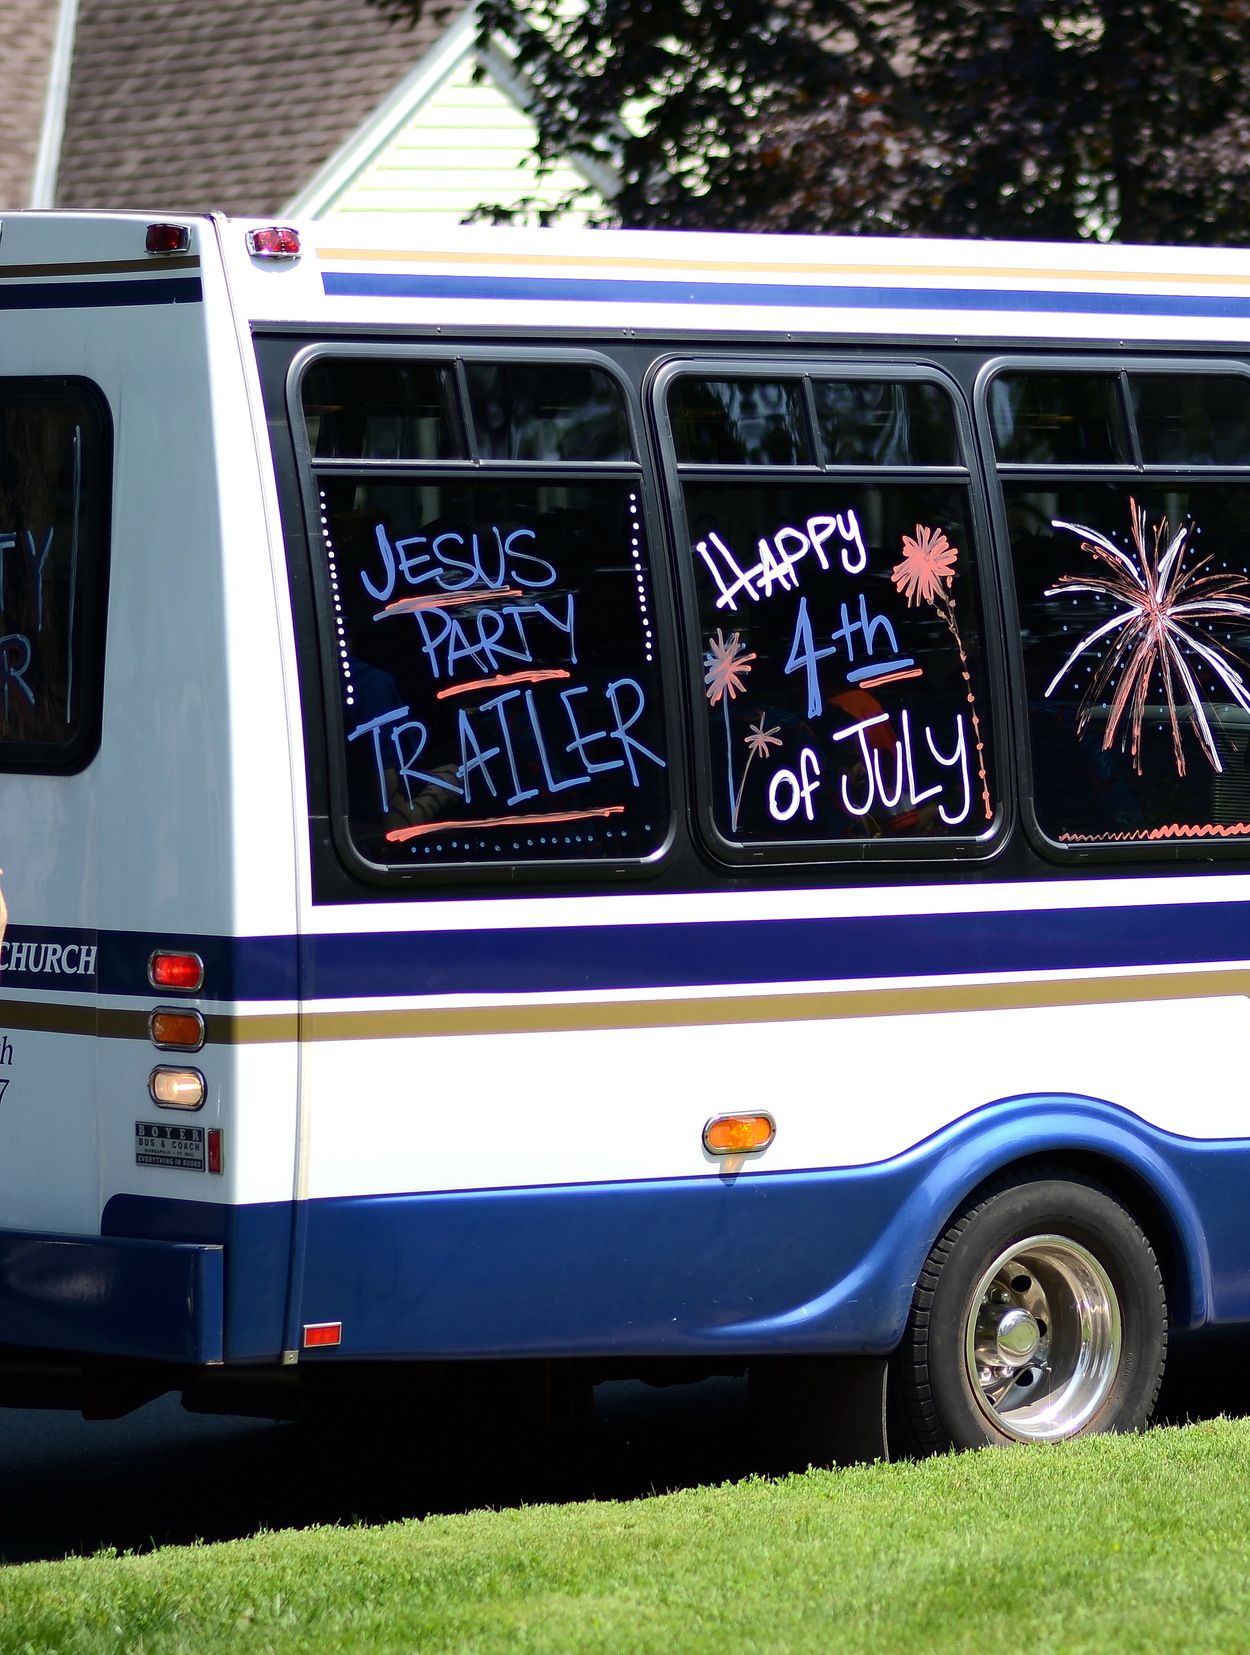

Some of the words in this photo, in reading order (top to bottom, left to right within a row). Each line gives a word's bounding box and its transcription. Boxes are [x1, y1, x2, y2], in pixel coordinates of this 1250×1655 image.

[361, 524, 557, 600] JESUS
[414, 594, 578, 678] PARTY
[784, 593, 899, 719] 4th
[348, 679, 666, 813] TRAILER
[769, 747, 821, 821] of
[832, 709, 970, 825] JULY
[0, 941, 98, 975] CHURCH
[138, 1125, 200, 1141] BOYER
[138, 1138, 155, 1147] BUS
[171, 1141, 200, 1151] COACH
